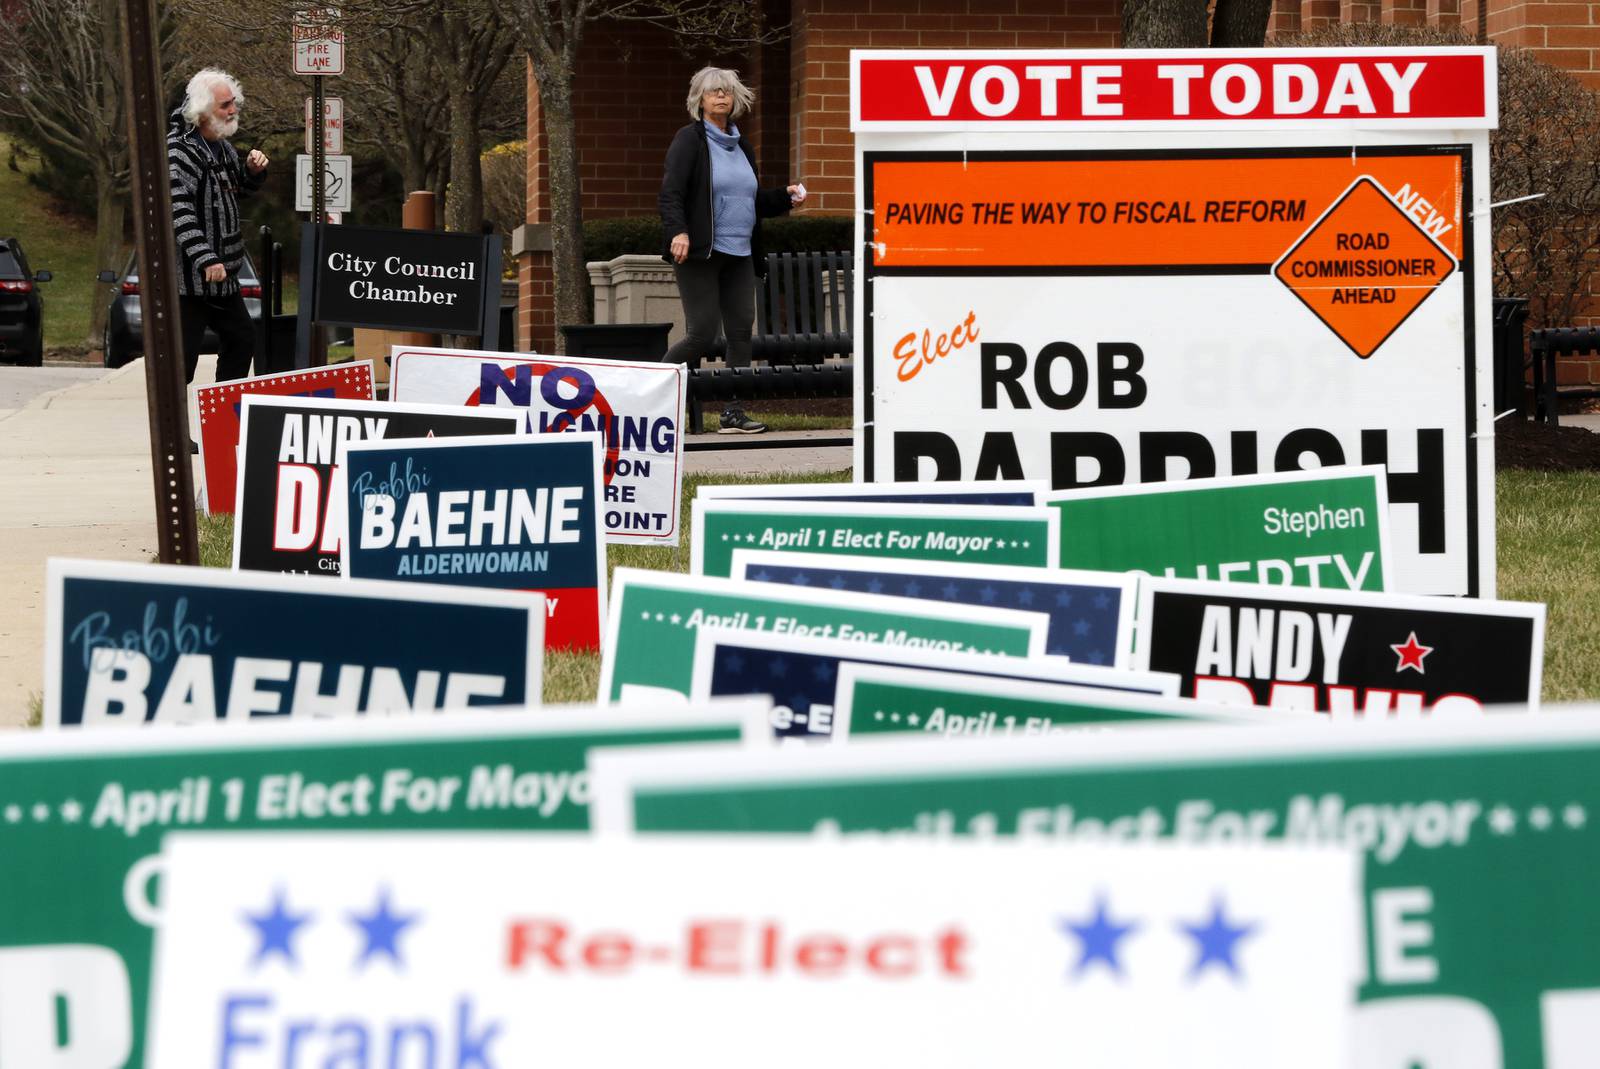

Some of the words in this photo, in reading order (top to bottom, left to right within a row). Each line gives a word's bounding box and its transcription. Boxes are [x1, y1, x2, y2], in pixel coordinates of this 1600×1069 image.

[307, 44, 329, 54] FIRE
[307, 57, 331, 67] LANE
[915, 64, 1124, 118] VOTE
[1158, 61, 1428, 115] TODAY
[885, 202, 965, 225] PAVING
[971, 202, 1015, 225] THE
[1020, 202, 1071, 225] WAY
[1076, 202, 1107, 224] TO
[1113, 200, 1196, 224] FISCAL
[1203, 200, 1307, 224] REFORM
[1393, 183, 1453, 239] NEW
[1336, 233, 1390, 251] ROAD
[327, 252, 377, 277] City
[384, 256, 475, 281] Council
[1291, 259, 1436, 278] COMMISSIONER
[349, 280, 457, 306] Chamber
[1331, 287, 1397, 305] AHEAD
[892, 310, 980, 382] Elect
[479, 363, 595, 410] NO
[980, 341, 1148, 411] ROB
[352, 457, 431, 511] Bobbi
[360, 486, 584, 550] BAEHNE
[605, 511, 667, 530] OINT
[760, 528, 812, 549] April
[816, 530, 826, 546] 1
[832, 529, 881, 549] Elect
[886, 530, 922, 549] For
[924, 532, 993, 554] Mayor
[1263, 507, 1365, 538] Stephen
[397, 551, 549, 575] ALDERWOMAN
[70, 597, 220, 674] Bobbi
[1195, 605, 1353, 684] ANDY
[92, 776, 209, 834] April
[222, 778, 244, 821] 1
[256, 775, 373, 820] Elect
[381, 770, 460, 814] For
[466, 766, 592, 818] Mayo
[1285, 795, 1480, 862] Mayor
[504, 917, 975, 983] Re-Elect
[220, 989, 504, 1069] Frank
